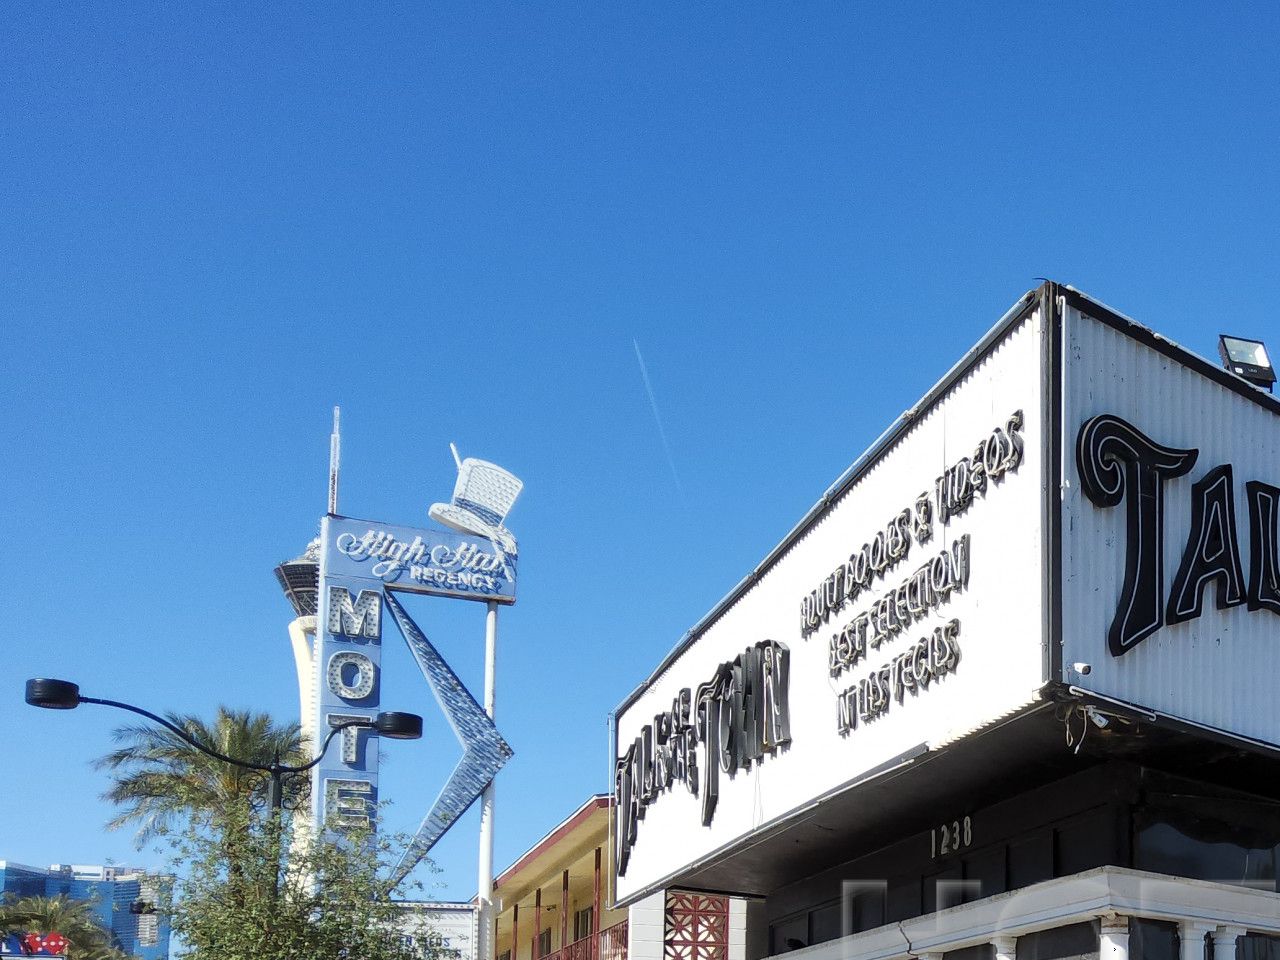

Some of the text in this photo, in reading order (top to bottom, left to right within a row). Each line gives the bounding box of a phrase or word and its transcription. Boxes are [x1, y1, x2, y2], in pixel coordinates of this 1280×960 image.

[336, 530, 427, 578] High
[410, 564, 497, 589] REGENCY
[800, 409, 1024, 640] ADULT BOOKS & VIDEOS
[829, 533, 971, 677] BEST SELECTION
[325, 585, 382, 830] MOTE
[837, 618, 962, 736] IN LAS VEGAS
[931, 815, 972, 859] 1238
